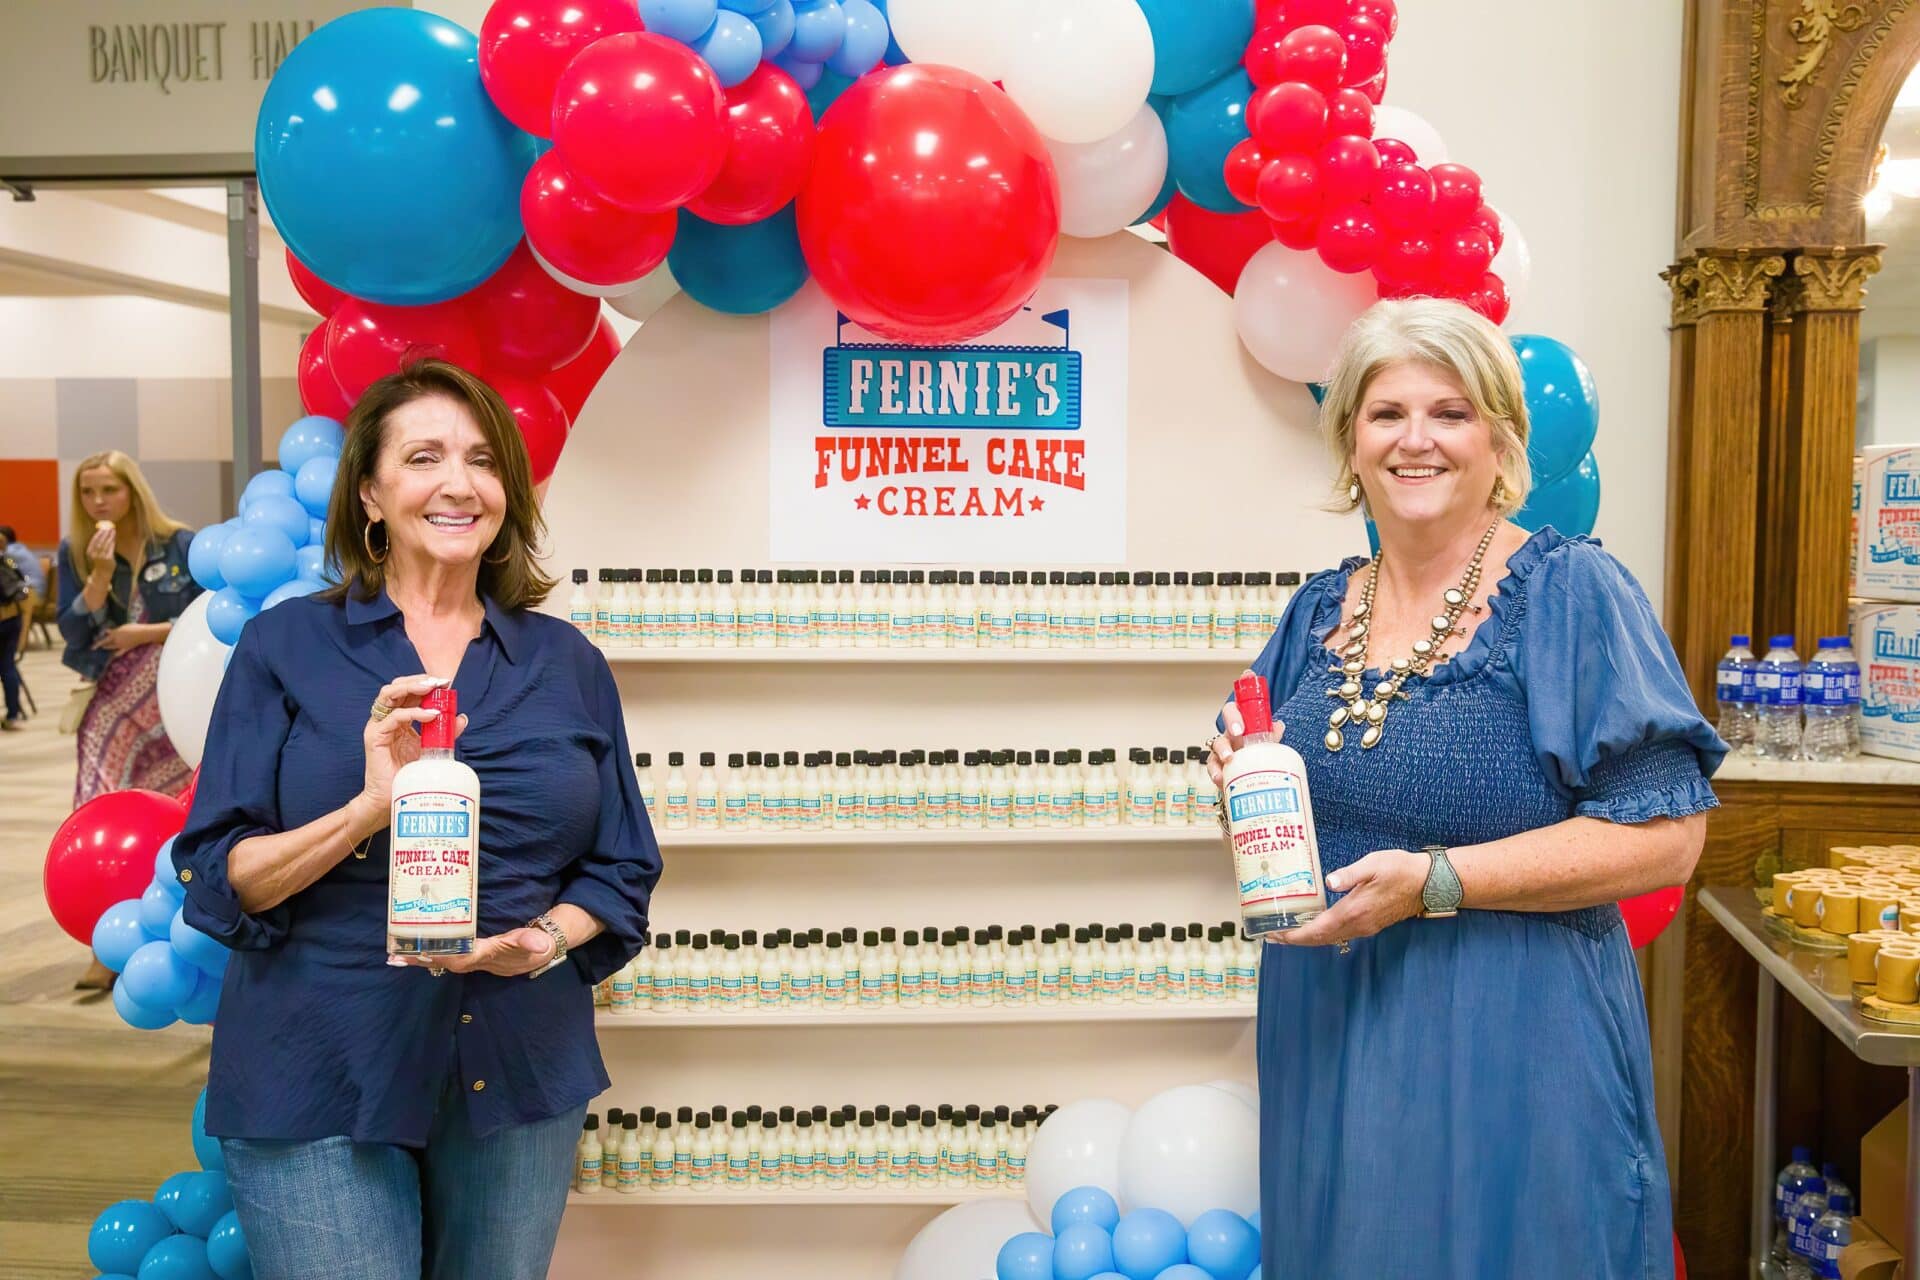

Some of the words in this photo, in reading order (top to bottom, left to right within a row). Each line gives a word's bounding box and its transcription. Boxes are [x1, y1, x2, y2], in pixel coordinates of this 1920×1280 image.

[88, 22, 227, 95] BANQUET
[251, 20, 315, 81] HA
[847, 359, 1062, 417] FERNIE'S
[814, 436, 970, 490] FUNNEL
[986, 437, 1086, 492] CAKE
[876, 486, 1026, 517] CREAM
[403, 815, 465, 834] FERNIE'S
[1233, 828, 1271, 850] FUNNEL
[1246, 840, 1290, 856] CREAM
[395, 850, 438, 867] FUNNEL
[442, 850, 469, 867] CAKE
[408, 865, 454, 876] CREAM
